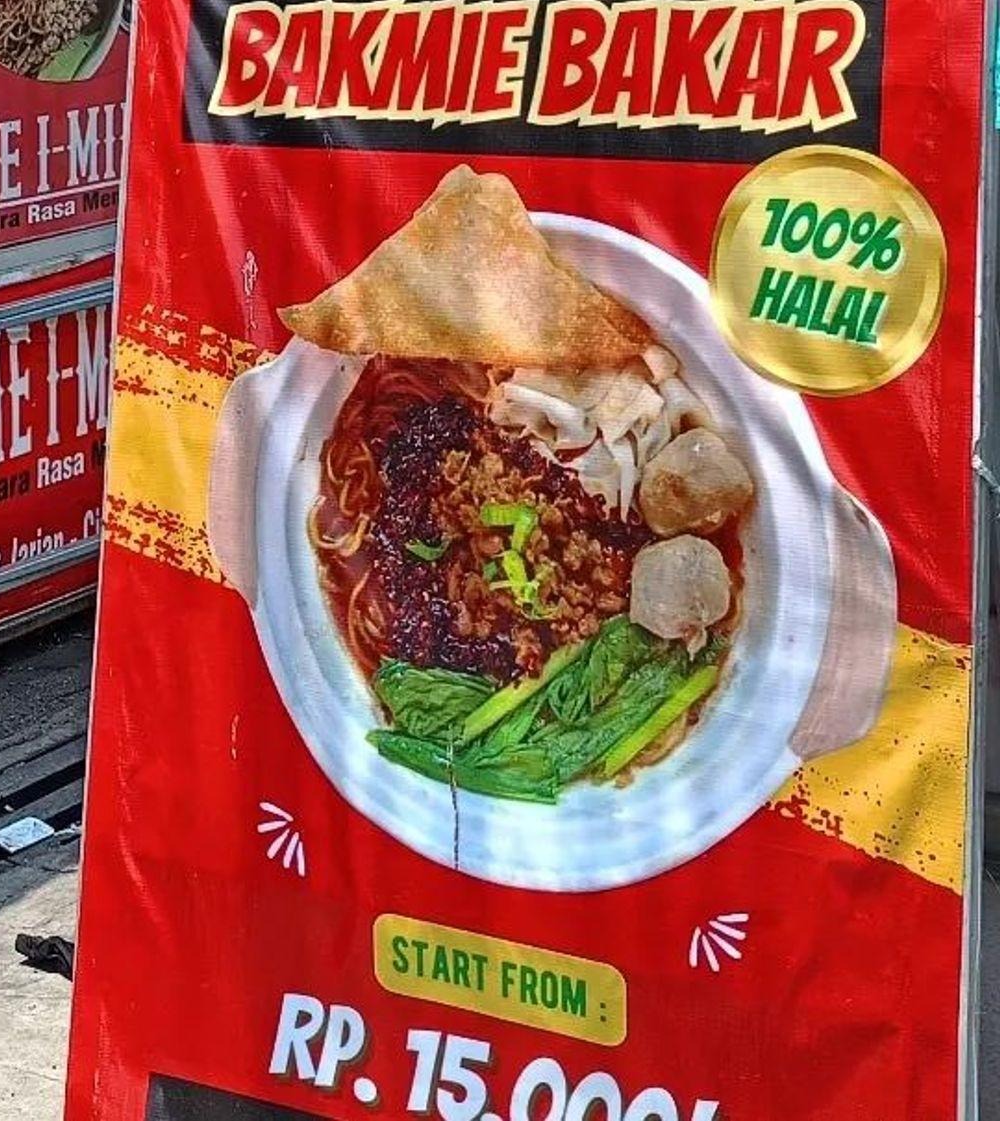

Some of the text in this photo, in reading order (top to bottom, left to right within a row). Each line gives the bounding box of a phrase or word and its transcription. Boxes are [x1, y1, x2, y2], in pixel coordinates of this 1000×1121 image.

[27, 199, 76, 224] Rasa
[760, 198, 903, 273] 100%
[750, 266, 887, 344] HALAL
[37, 451, 84, 488] Rasa
[391, 935, 489, 992] START
[500, 961, 588, 1018] FROM
[268, 992, 379, 1104] RP.
